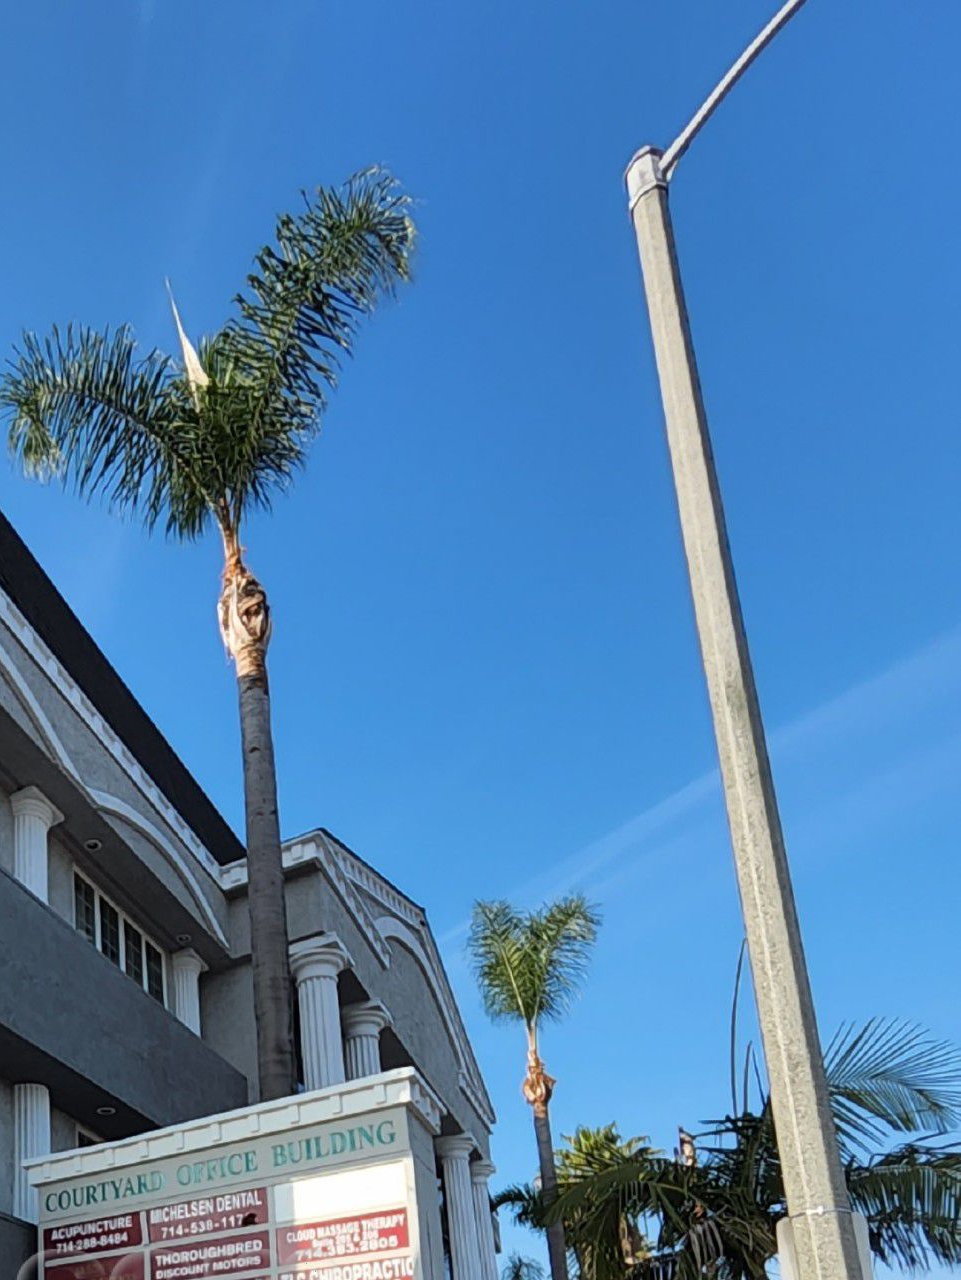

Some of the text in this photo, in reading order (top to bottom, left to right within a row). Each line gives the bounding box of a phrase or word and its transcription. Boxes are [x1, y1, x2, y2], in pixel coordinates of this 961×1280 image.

[45, 1120, 397, 1212] COURTYARD OFFICE BUILDING
[150, 1190, 262, 1225] MICHELSEN DENTAL
[51, 1216, 133, 1241] ACUPUNCTURE
[161, 1213, 257, 1239] 714-538-117
[286, 1213, 405, 1243] CLOUD MASSAGE THERAPY
[155, 1239, 263, 1267] THOROUGHBRED
[155, 1255, 261, 1280] DISCOUNT MOTORS
